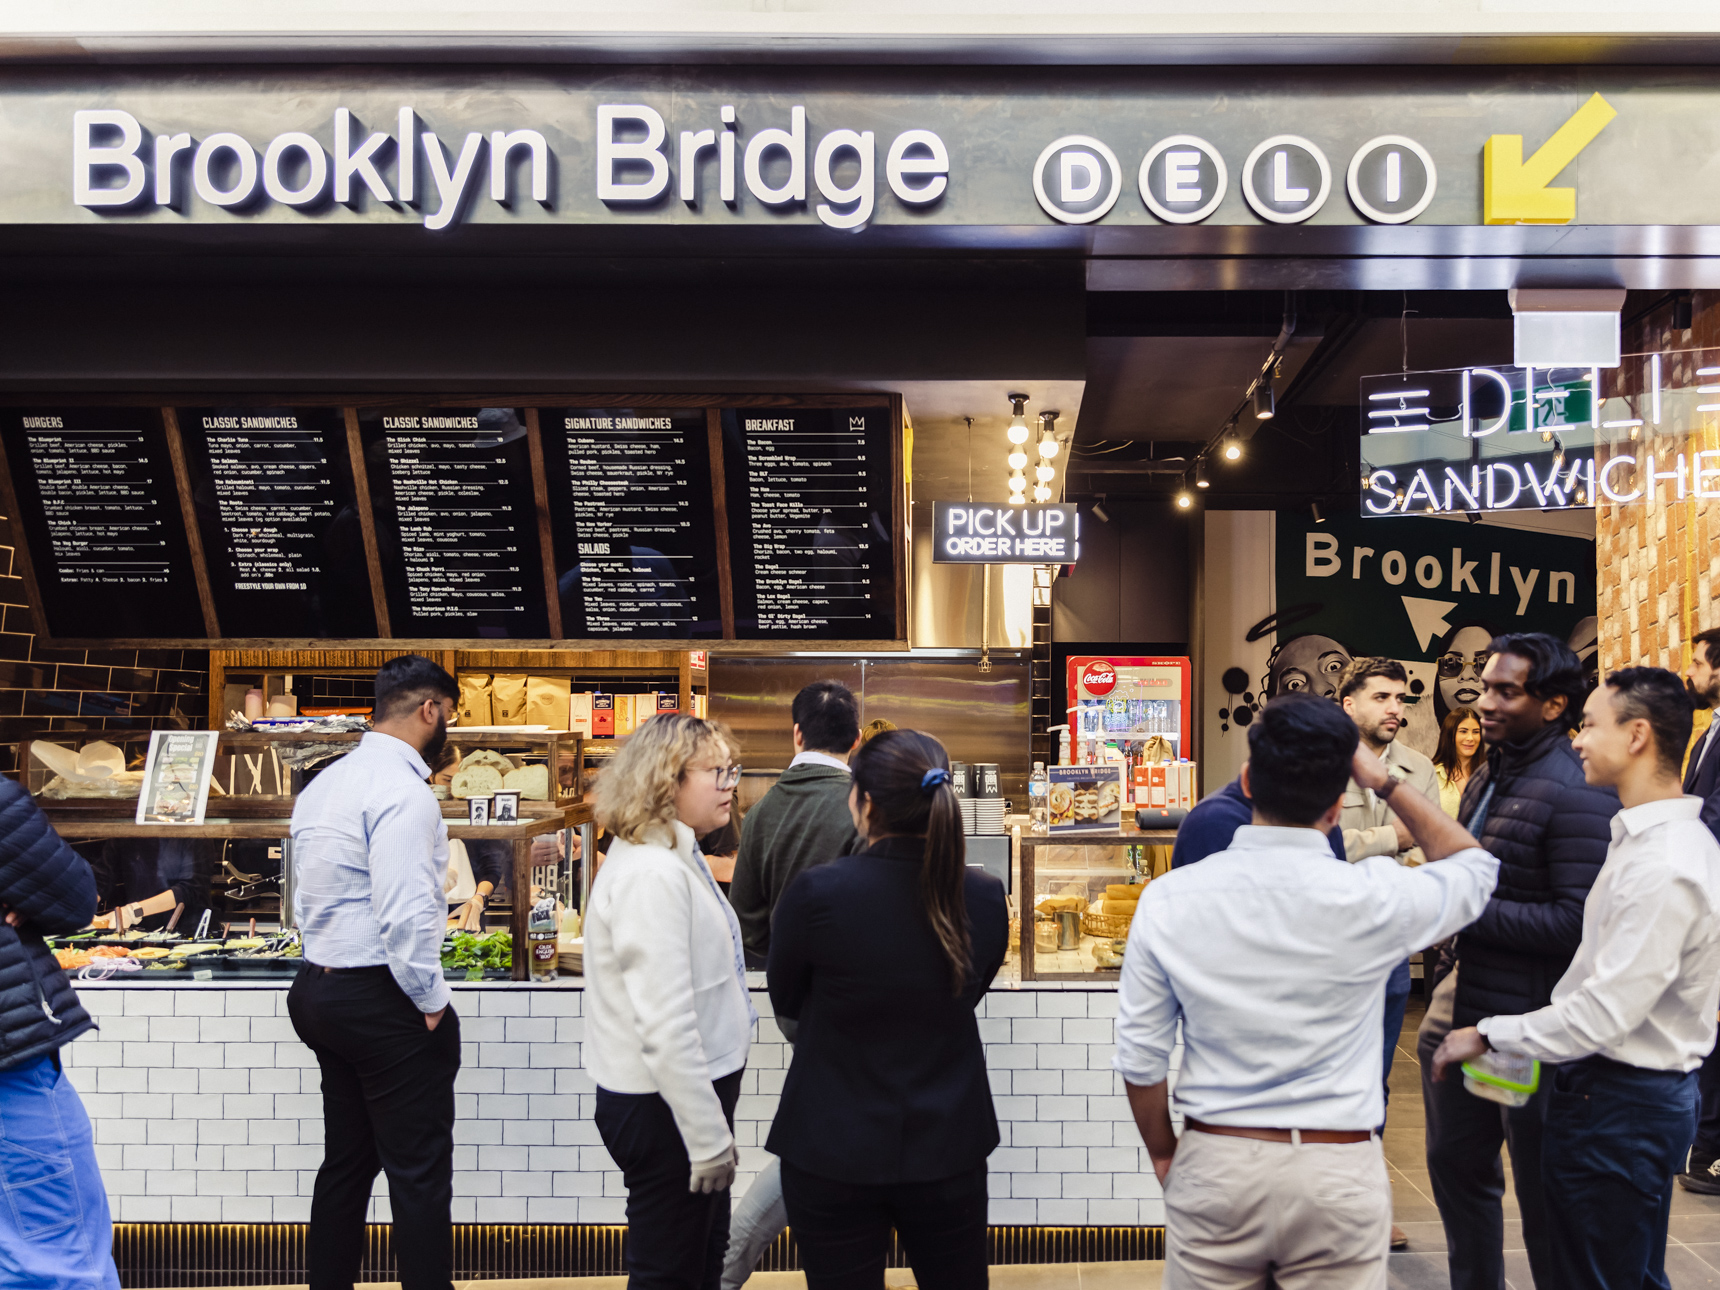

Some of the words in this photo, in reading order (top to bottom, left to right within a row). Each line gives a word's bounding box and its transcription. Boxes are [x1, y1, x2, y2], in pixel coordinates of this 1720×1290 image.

[73, 107, 549, 230] Brooklyn
[596, 104, 949, 229] Bridge
[1461, 354, 1662, 439] DELI
[23, 417, 63, 428] BURGERS
[202, 417, 240, 429] CLASSIC
[241, 417, 298, 429] SANDWICHES
[383, 417, 420, 429] CLASSIC
[422, 417, 478, 429] SANDWICHES
[564, 418, 613, 429] SIGNATURE
[615, 418, 672, 429] SANDWICHES
[745, 419, 795, 431] BREAKFAST
[948, 508, 1016, 535] PICK
[1022, 508, 1065, 536] UP
[578, 543, 610, 554] SALADS
[946, 537, 1011, 555] ORDER
[1014, 537, 1066, 556] HERE
[1305, 532, 1577, 616] Brooklyn
[1084, 672, 1115, 684] Coca-Cola
[168, 735, 194, 743] Opening
[169, 744, 193, 752] Special
